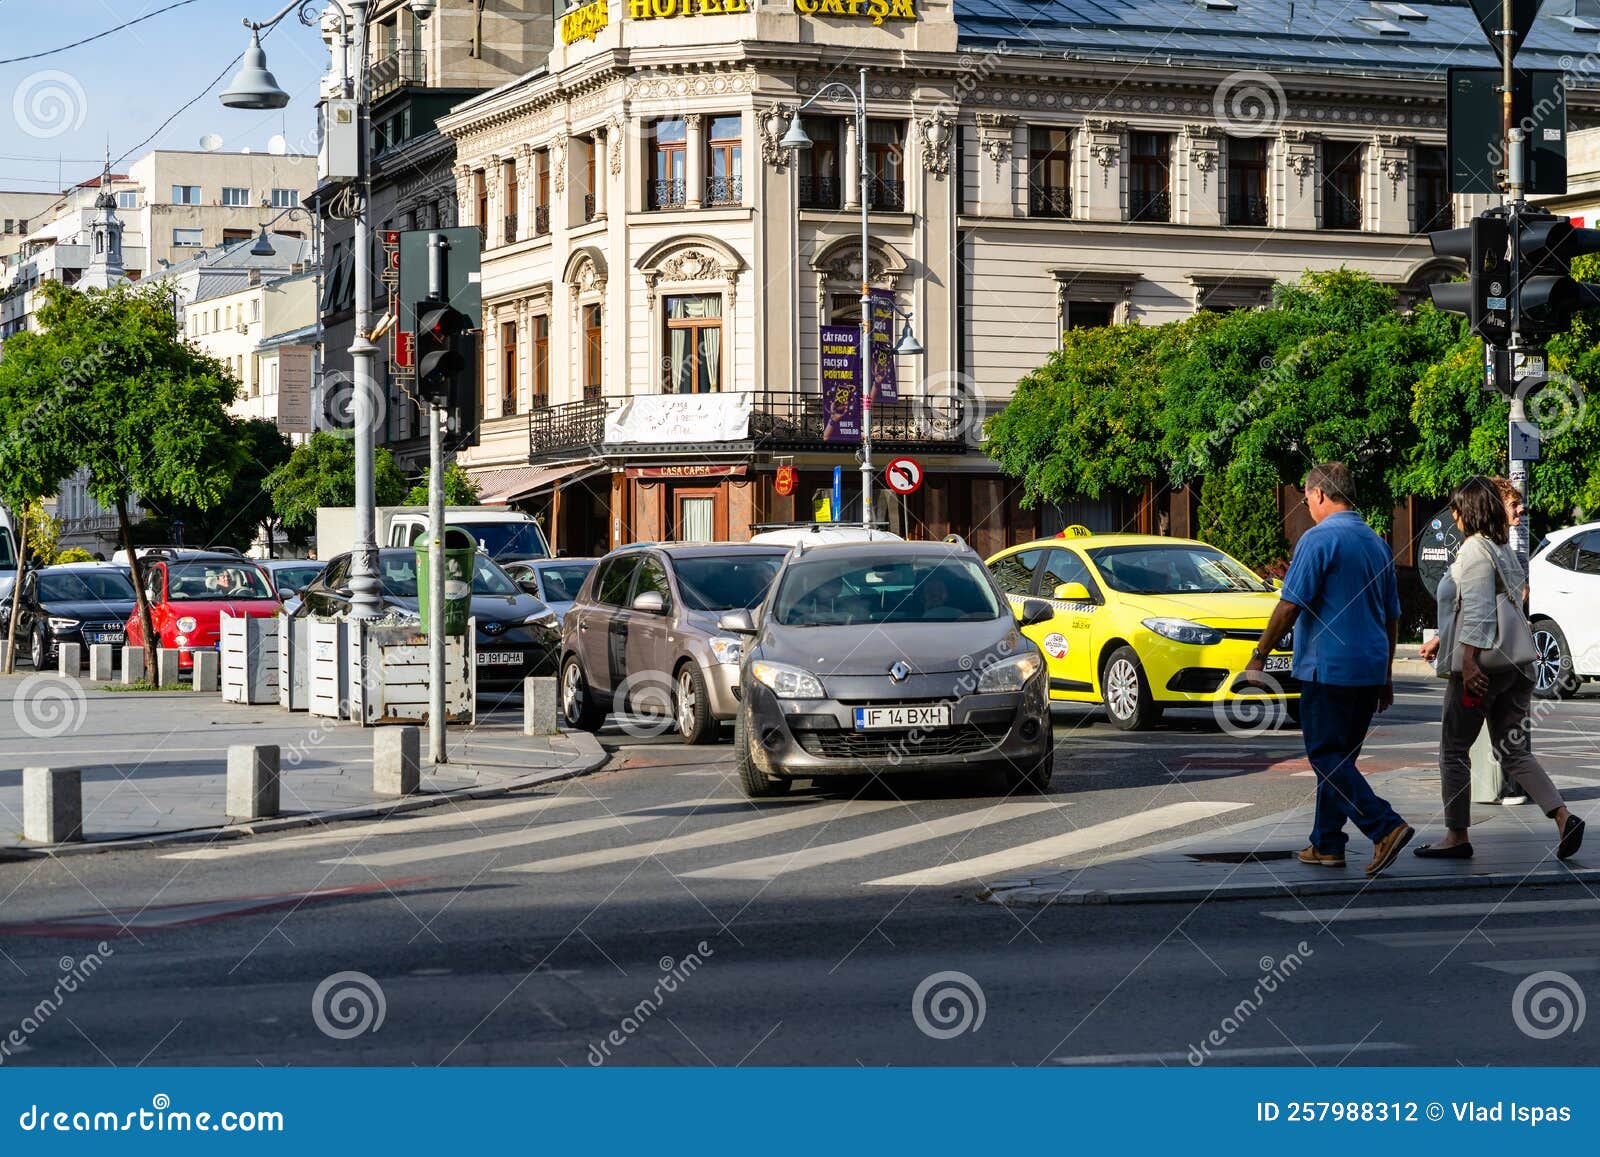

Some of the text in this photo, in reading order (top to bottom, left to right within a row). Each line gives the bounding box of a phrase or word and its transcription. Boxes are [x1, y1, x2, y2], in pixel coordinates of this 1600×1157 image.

[660, 466, 682, 475] CASA
[1071, 526, 1087, 537] TAXI
[867, 708, 941, 726] IF 14 BXH
